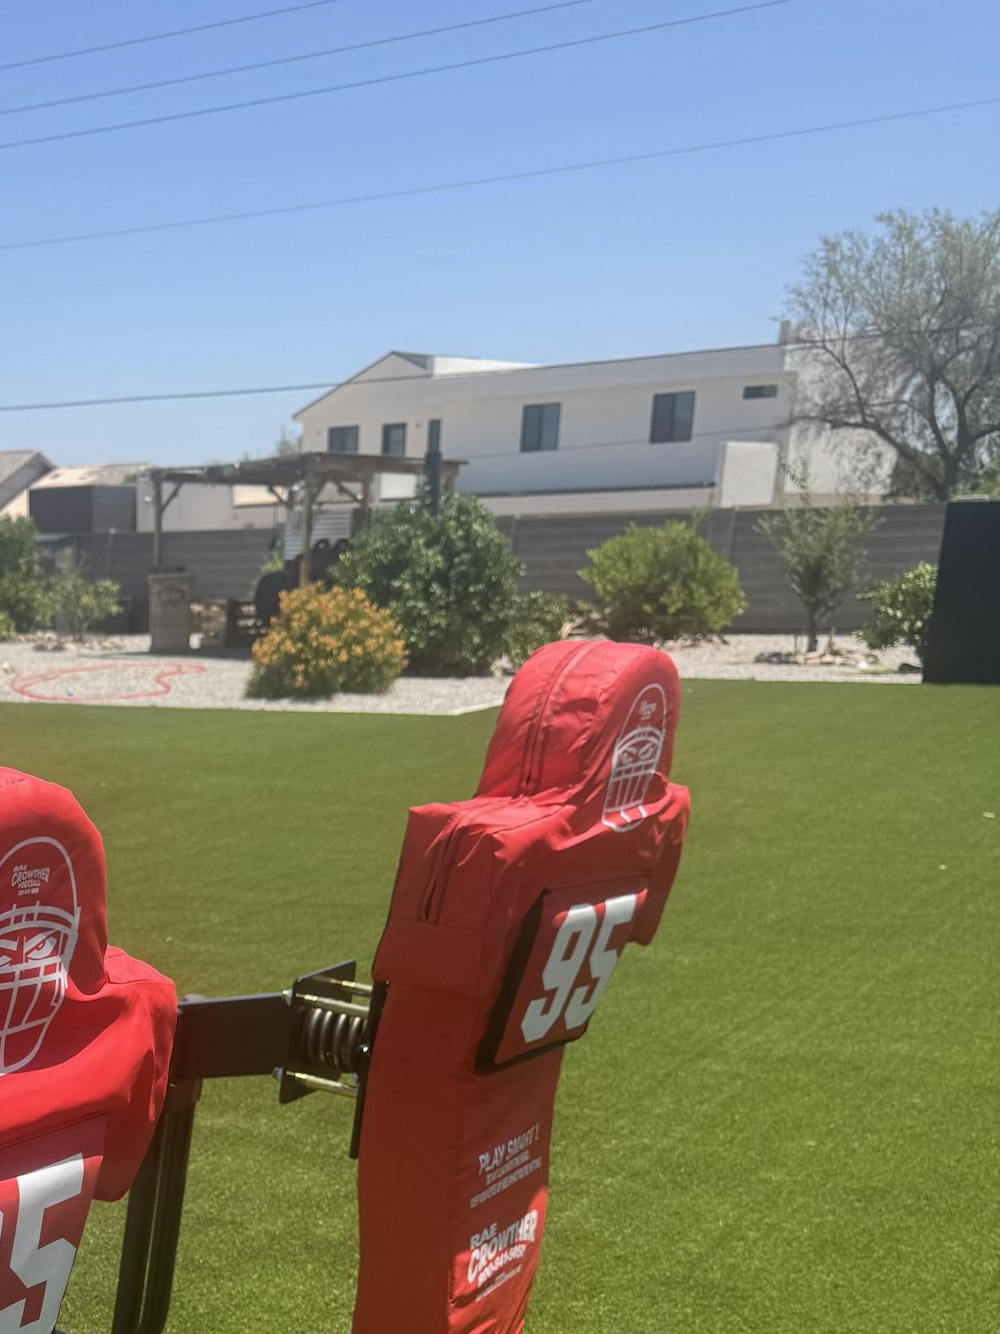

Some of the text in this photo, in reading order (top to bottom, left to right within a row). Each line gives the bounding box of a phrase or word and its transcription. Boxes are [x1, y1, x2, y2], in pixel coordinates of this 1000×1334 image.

[520, 893, 636, 1042] 95
[479, 1144, 506, 1175] PLAY
[468, 1209, 538, 1284] CROWTHER
[470, 1222, 497, 1250] RAE
